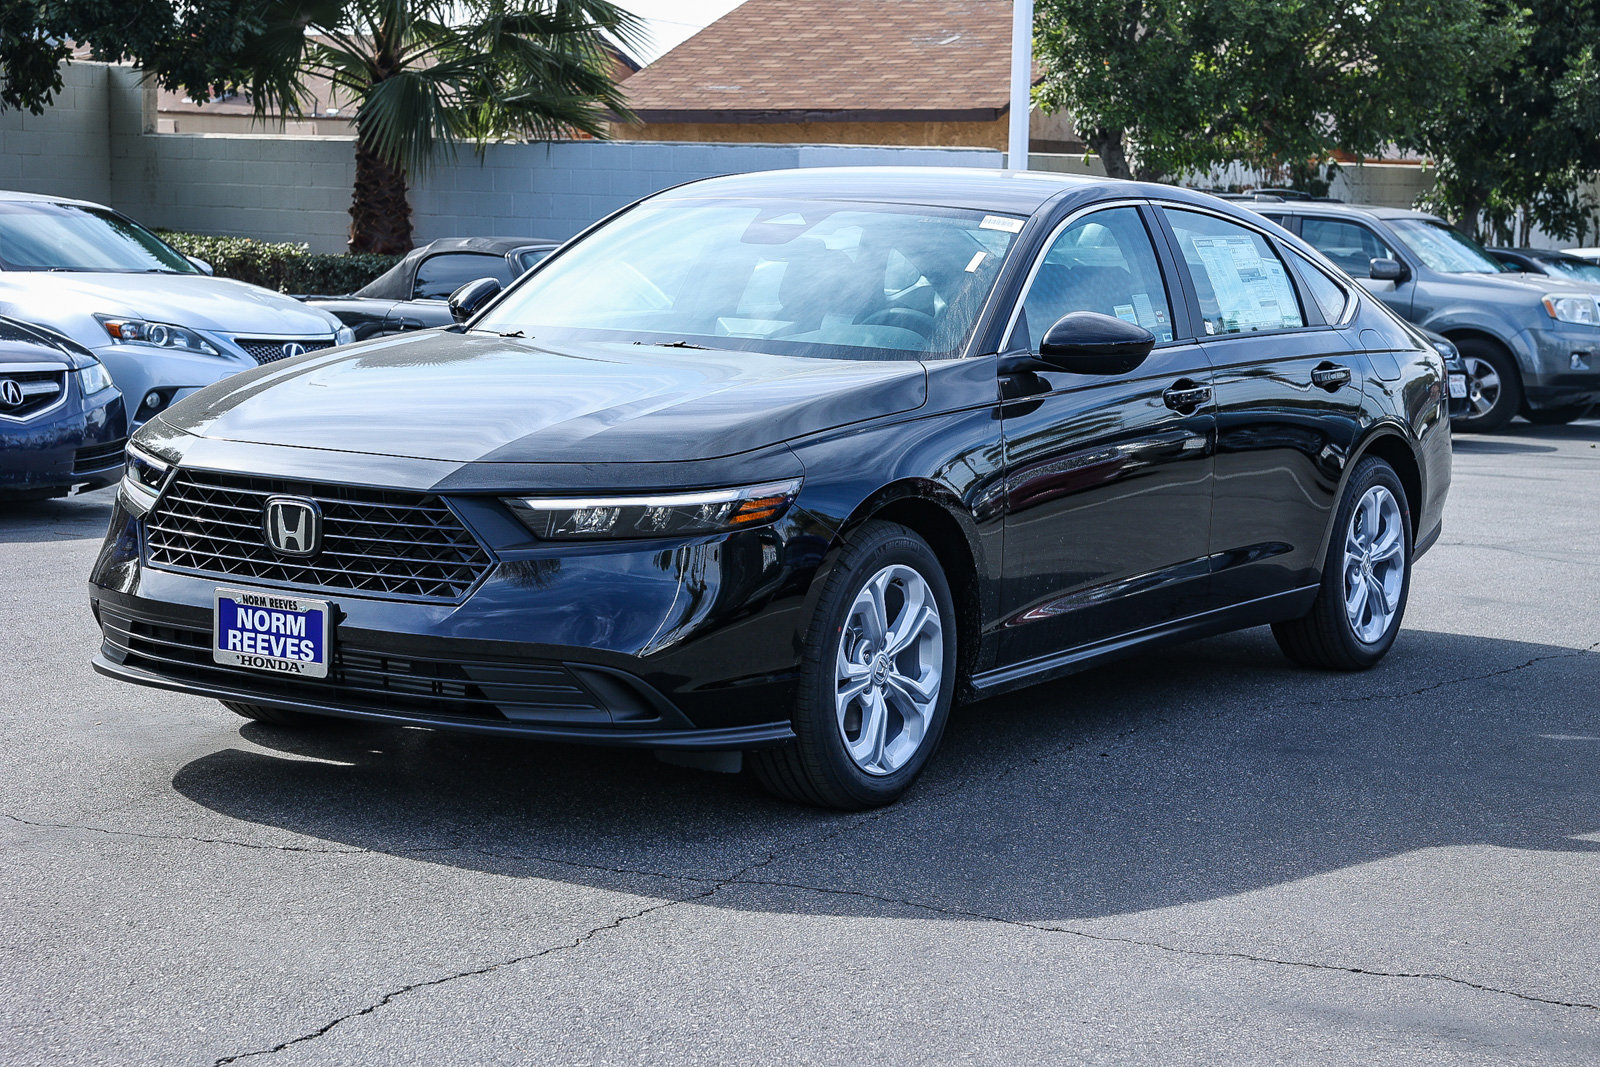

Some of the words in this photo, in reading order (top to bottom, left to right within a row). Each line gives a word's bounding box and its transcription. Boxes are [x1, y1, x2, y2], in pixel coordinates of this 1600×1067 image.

[242, 595, 267, 607] NORM
[269, 597, 298, 611] REEVES
[237, 607, 306, 637] NORM
[227, 629, 315, 662] REEVES
